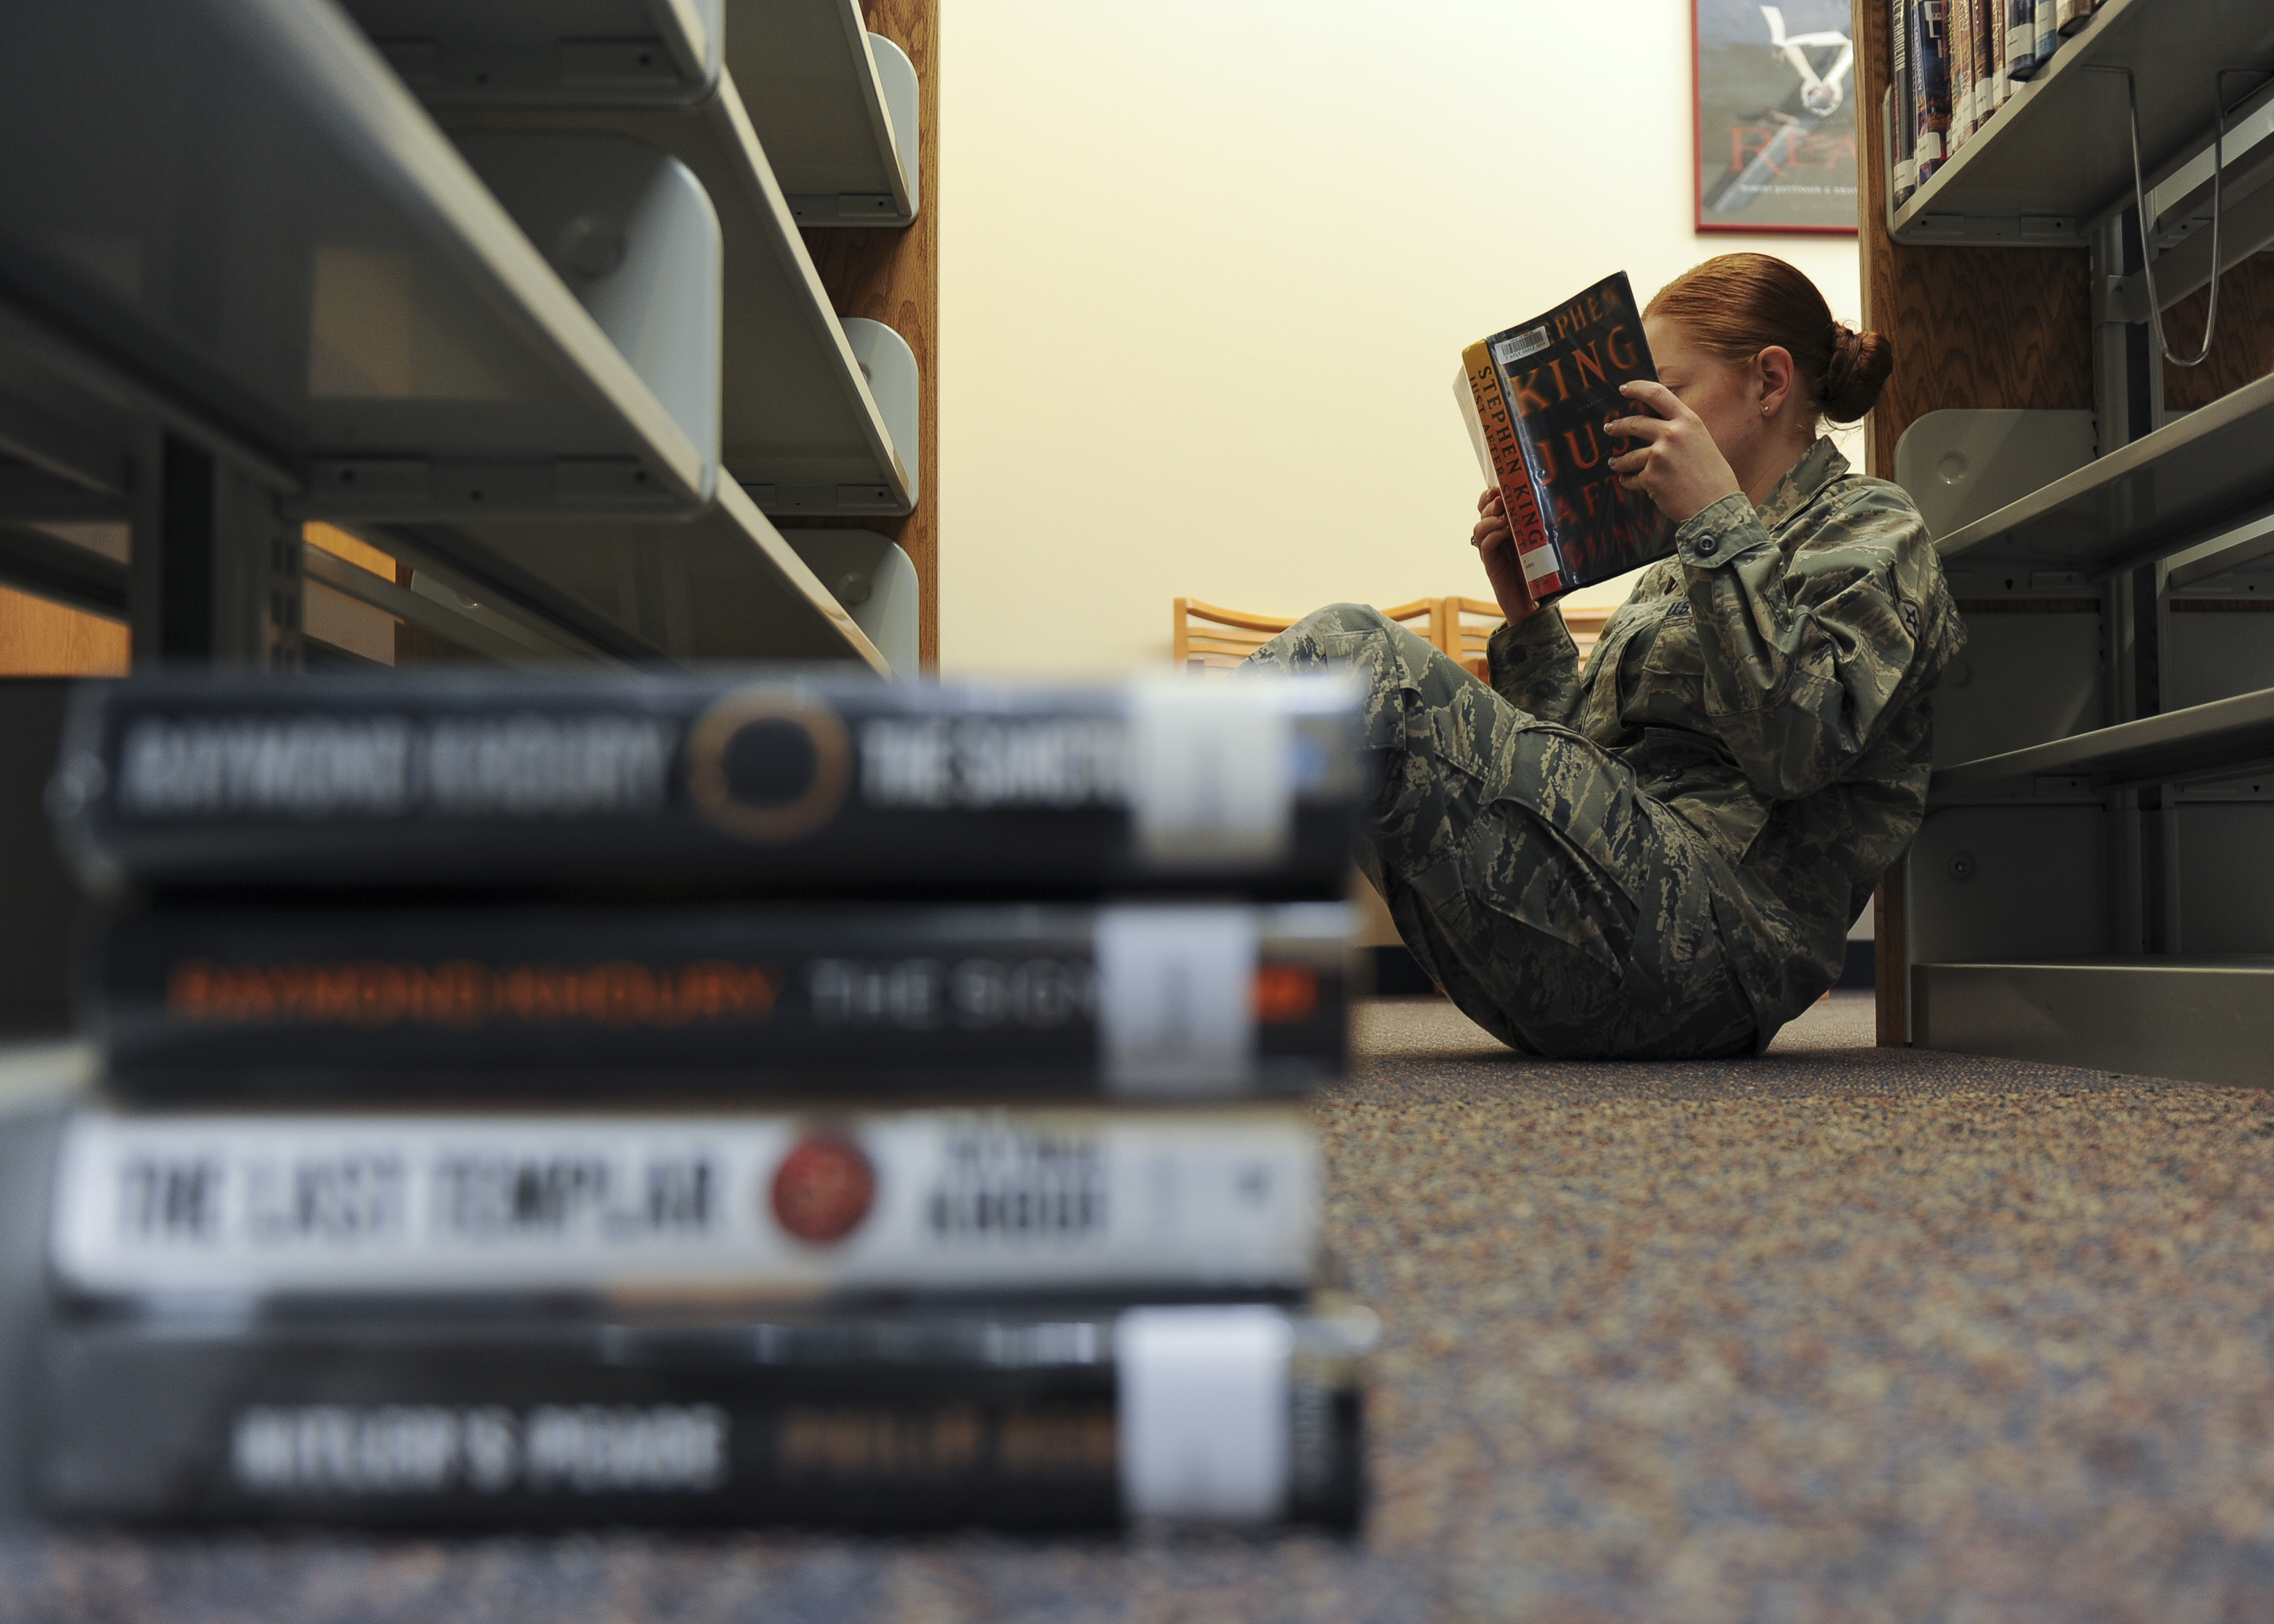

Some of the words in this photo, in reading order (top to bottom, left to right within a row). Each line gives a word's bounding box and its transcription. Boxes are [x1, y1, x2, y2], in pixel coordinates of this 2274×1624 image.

[1894, 21, 1905, 72] HAMILTON
[1730, 126, 1857, 179] REA
[1510, 325, 1639, 418] KING
[1469, 375, 1487, 415] JUST
[1482, 423, 1505, 477] AFTER
[1500, 483, 1527, 549] SUNSET
[1478, 365, 1523, 475] STEPHEN
[1513, 482, 1545, 546] KING
[1535, 399, 1651, 486] JUS
[1555, 473, 1625, 527] AFT
[809, 961, 936, 1029] THE
[123, 1153, 217, 1240] THE
[249, 1153, 403, 1240] LAST
[431, 1153, 715, 1240] TEMPLAR
